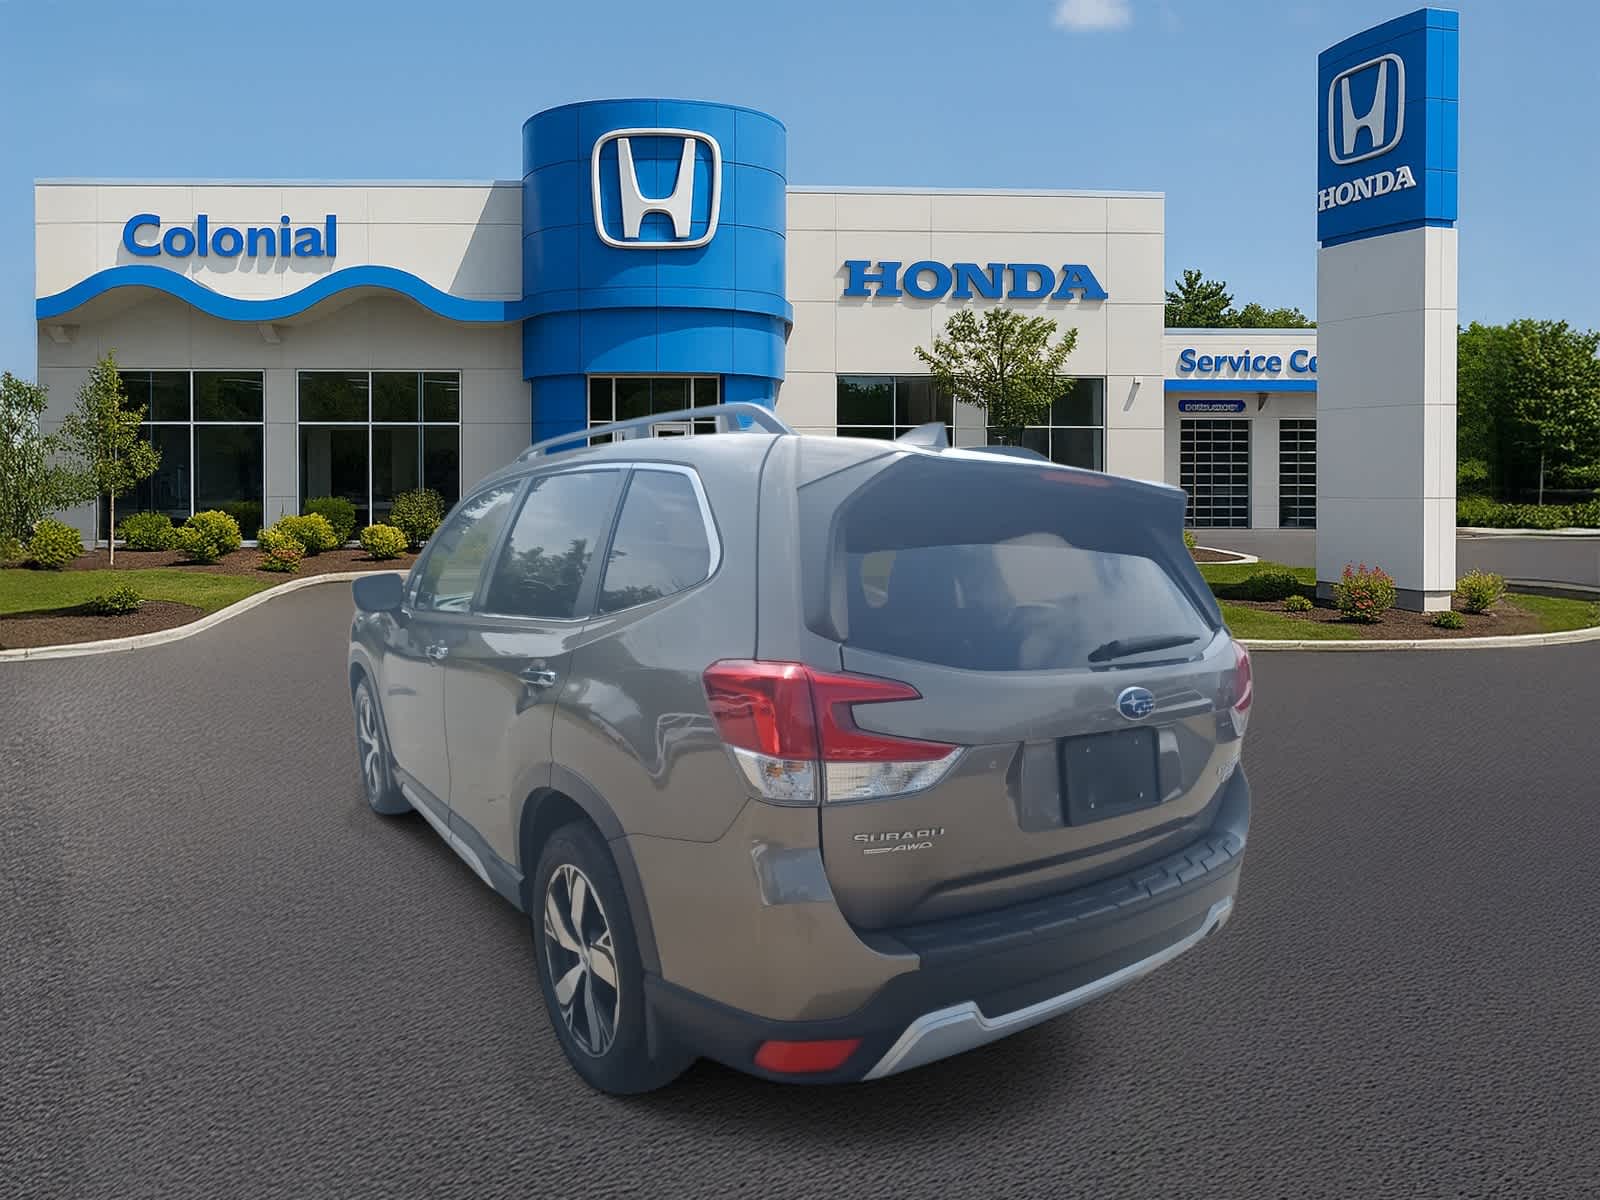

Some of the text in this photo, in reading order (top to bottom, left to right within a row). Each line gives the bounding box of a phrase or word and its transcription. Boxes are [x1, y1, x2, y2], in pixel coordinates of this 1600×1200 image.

[1318, 165, 1417, 212] HONDA
[122, 213, 337, 258] Colonial
[843, 260, 1109, 300] HONDA
[1179, 348, 1282, 373] Service
[853, 828, 945, 843] SUBARU
